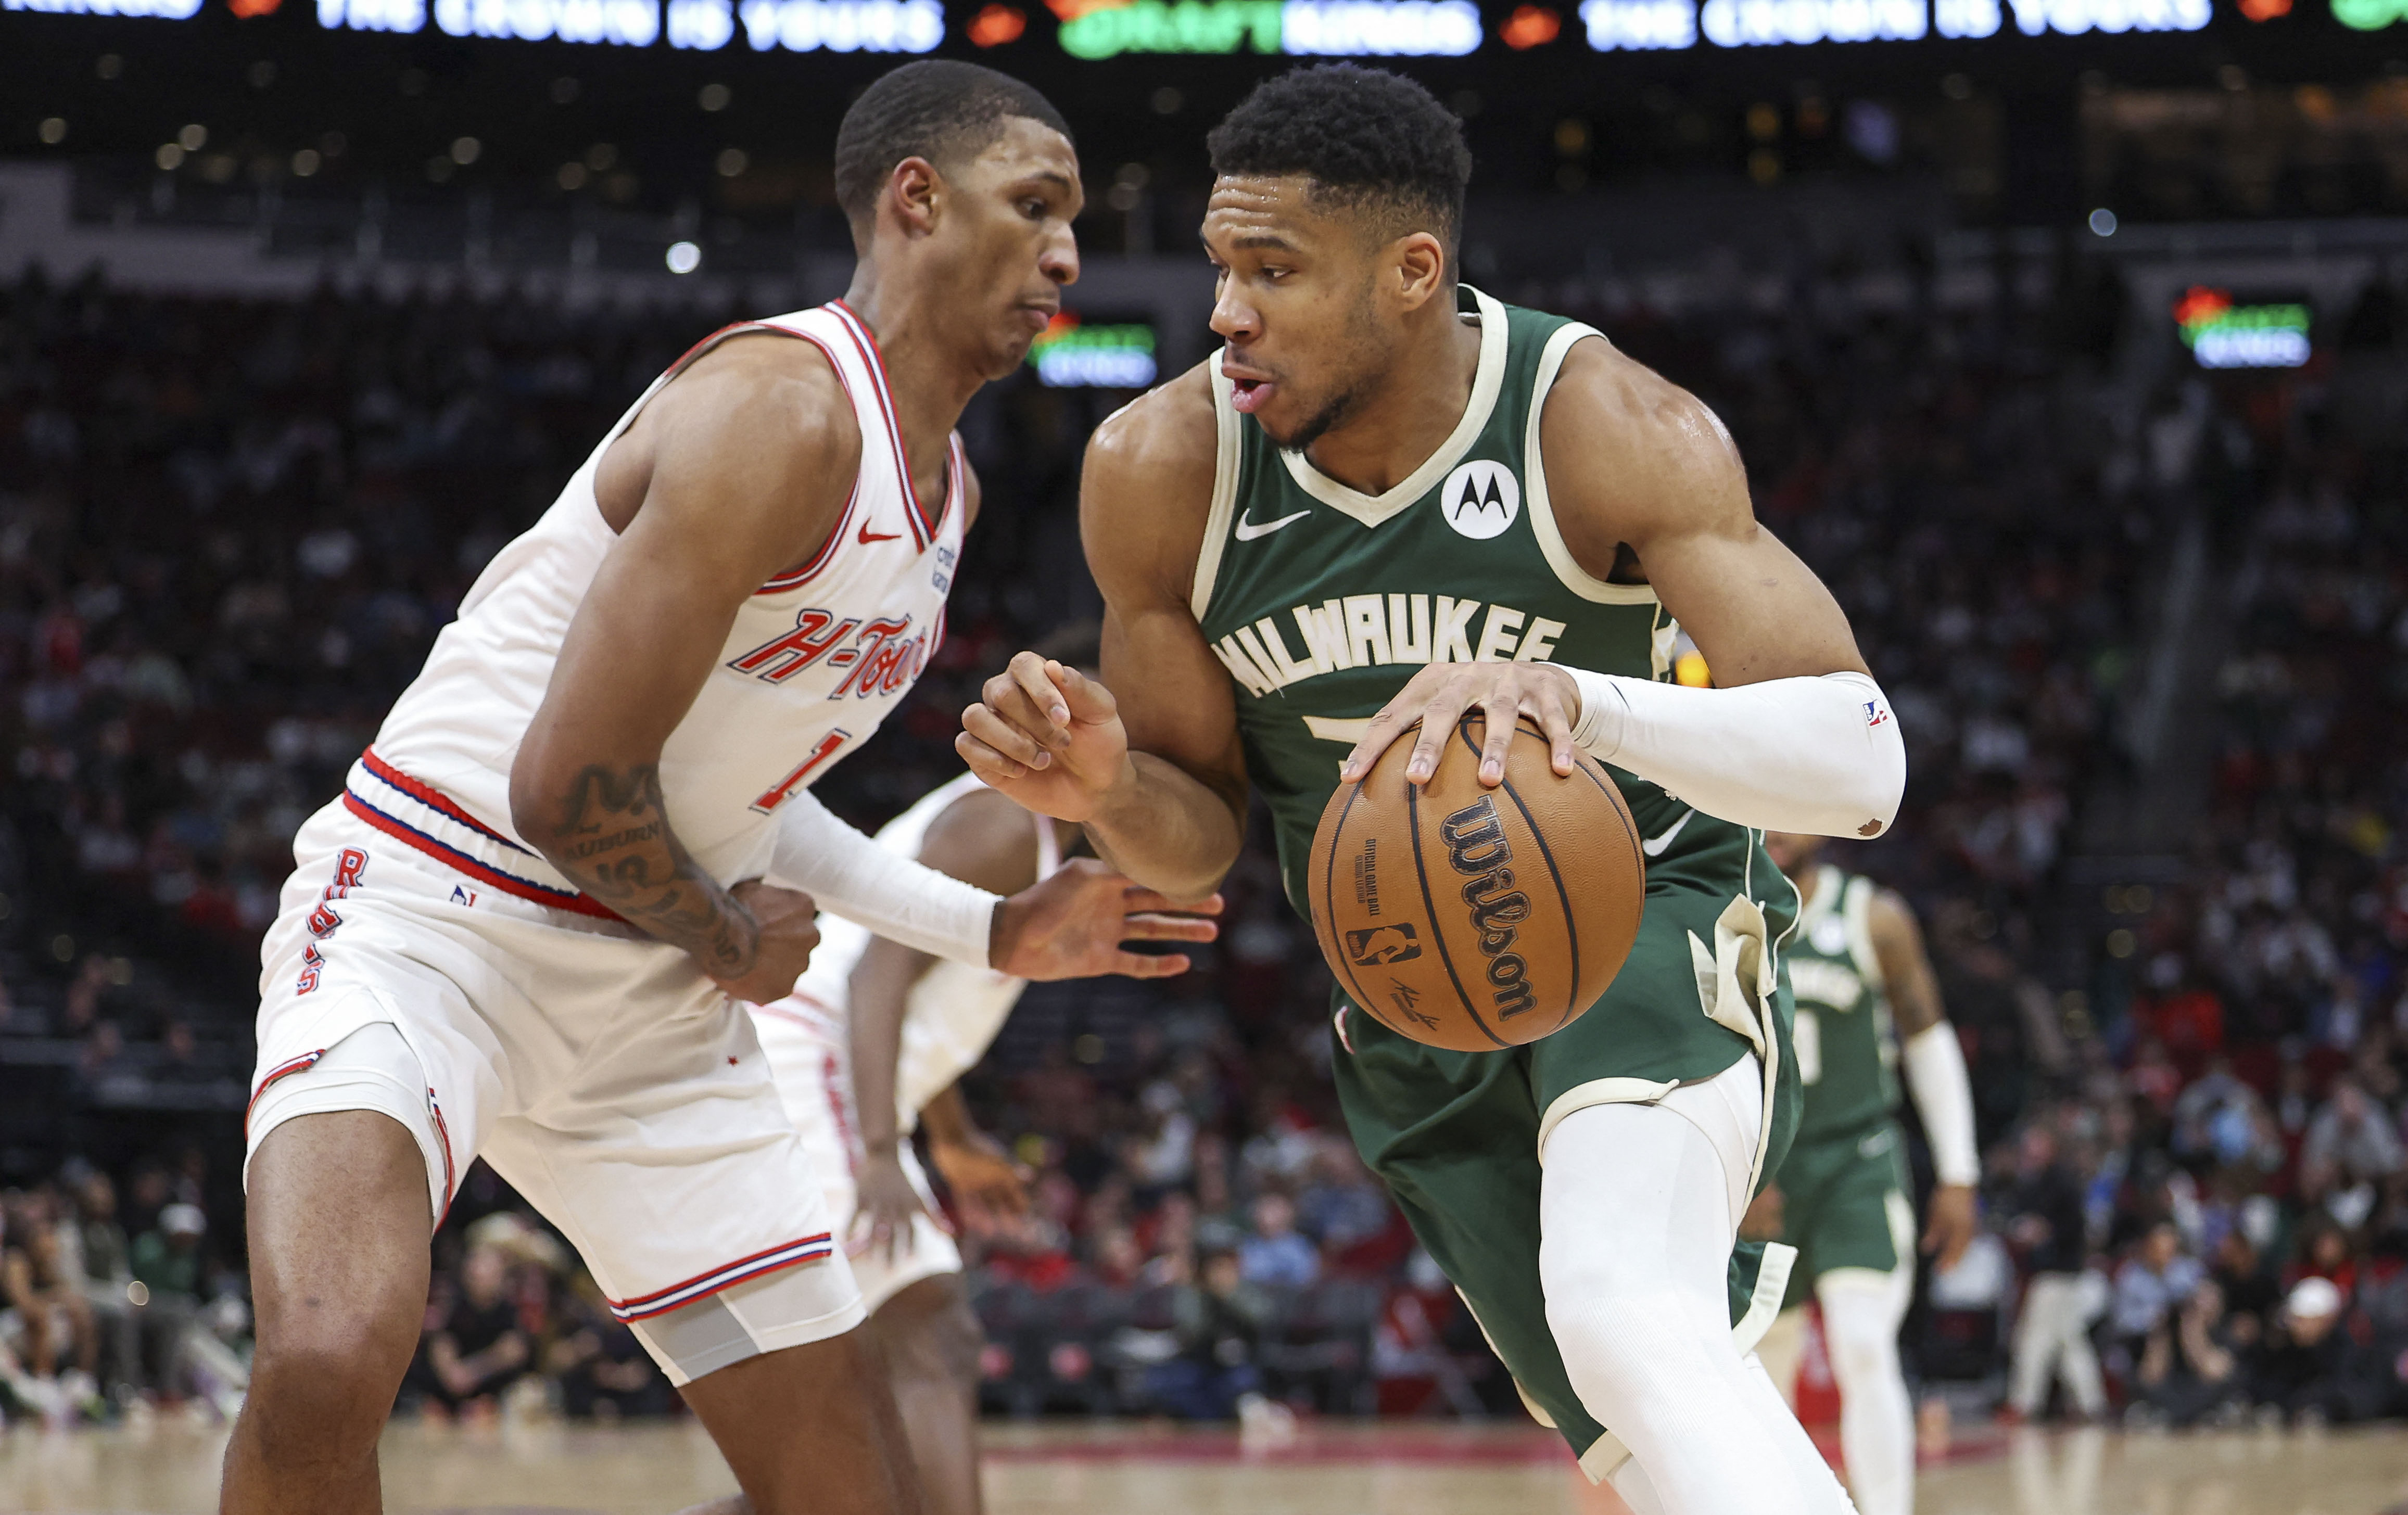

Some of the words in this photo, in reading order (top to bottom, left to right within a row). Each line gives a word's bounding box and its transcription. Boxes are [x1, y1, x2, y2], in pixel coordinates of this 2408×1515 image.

[434, 0, 660, 47] CROWN
[667, 0, 733, 50] IS
[738, 0, 945, 52] YOURS
[1579, 0, 1698, 51] THE
[1701, 0, 1928, 48] CROWN
[1933, 0, 2002, 39] IS
[1210, 593, 1567, 698] MILWAUKEE
[1862, 704, 1873, 721] NBA
[748, 728, 852, 816] 1
[1364, 838, 1376, 872] OFFICIAL
[1365, 874, 1377, 897] GAME
[1367, 898, 1380, 916] BALL
[1440, 794, 1537, 1022] Wilson
